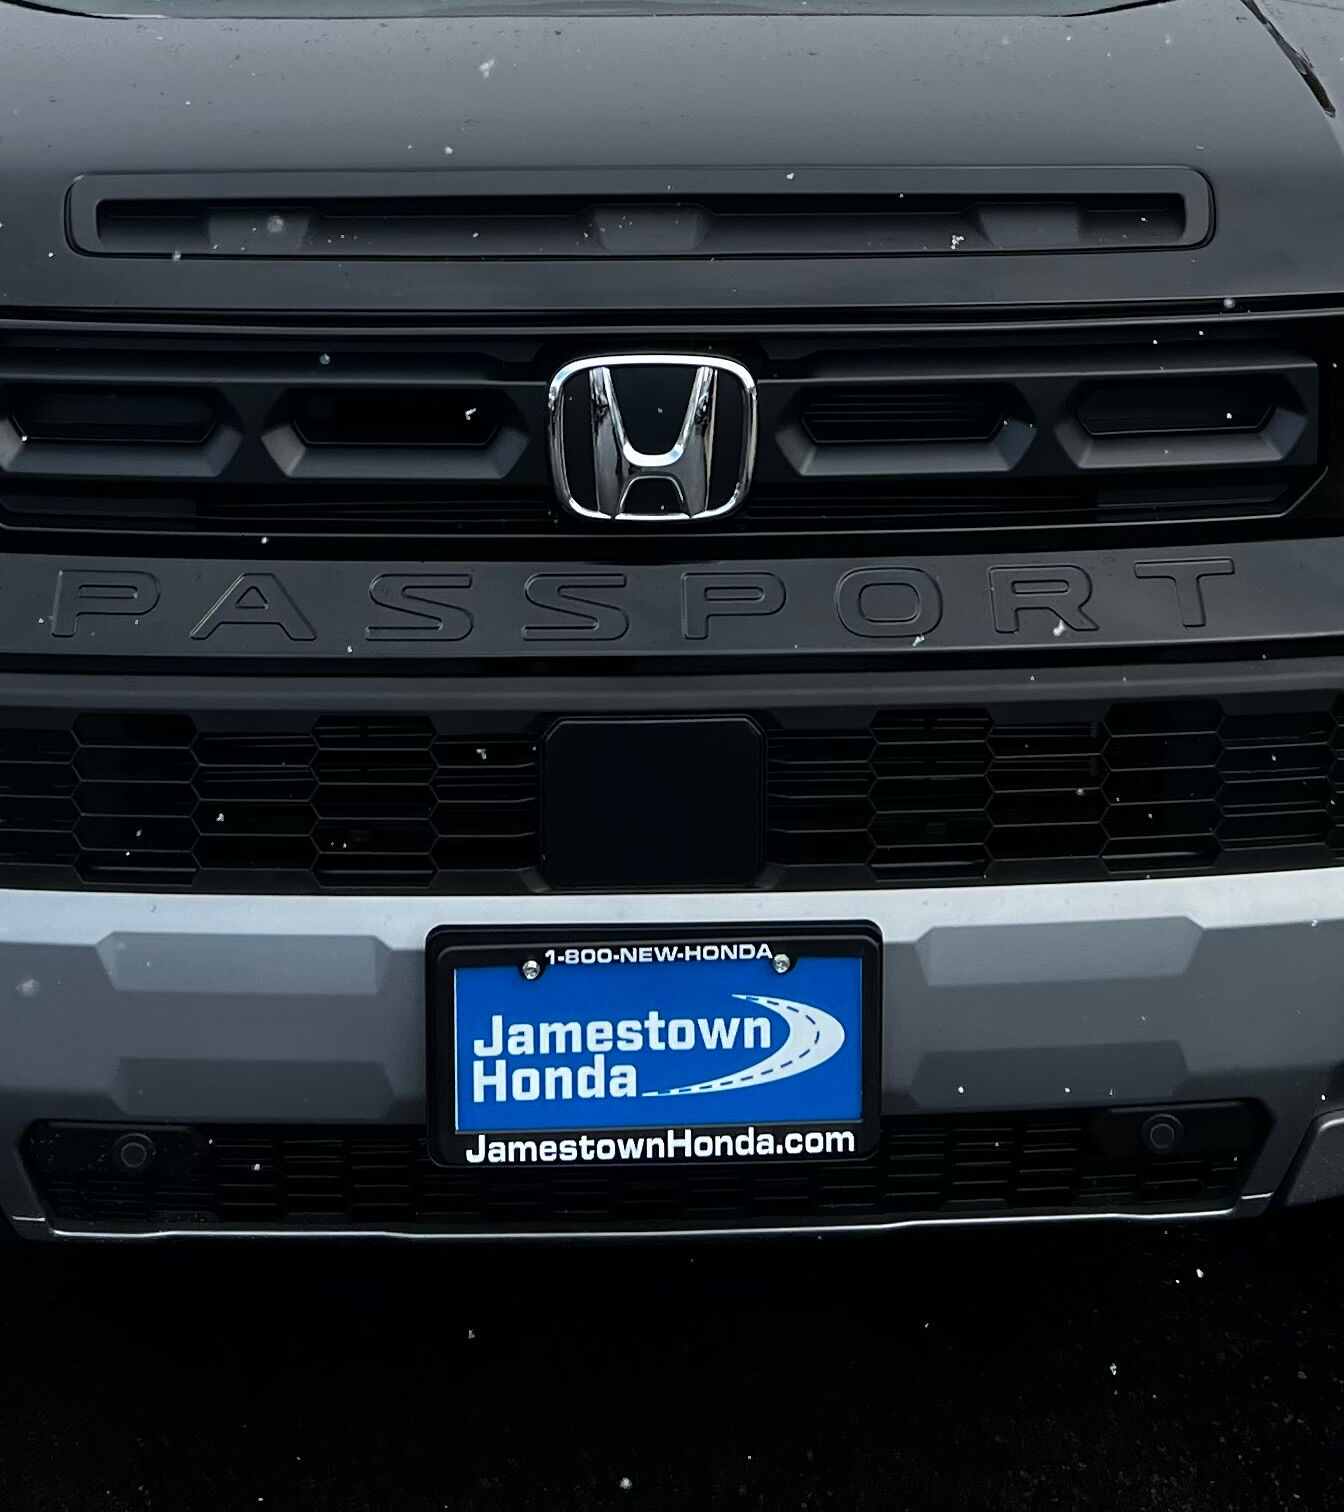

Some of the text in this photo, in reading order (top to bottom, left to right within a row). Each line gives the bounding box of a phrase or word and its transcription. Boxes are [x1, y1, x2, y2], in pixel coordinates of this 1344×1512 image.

[51, 556, 1235, 642] PASSPORT
[545, 943, 773, 965] 1-800-NEW-HONDA
[473, 1011, 771, 1057] Jamestown
[473, 1054, 637, 1103] Honda
[465, 1127, 856, 1164] JamestownHonda.com
